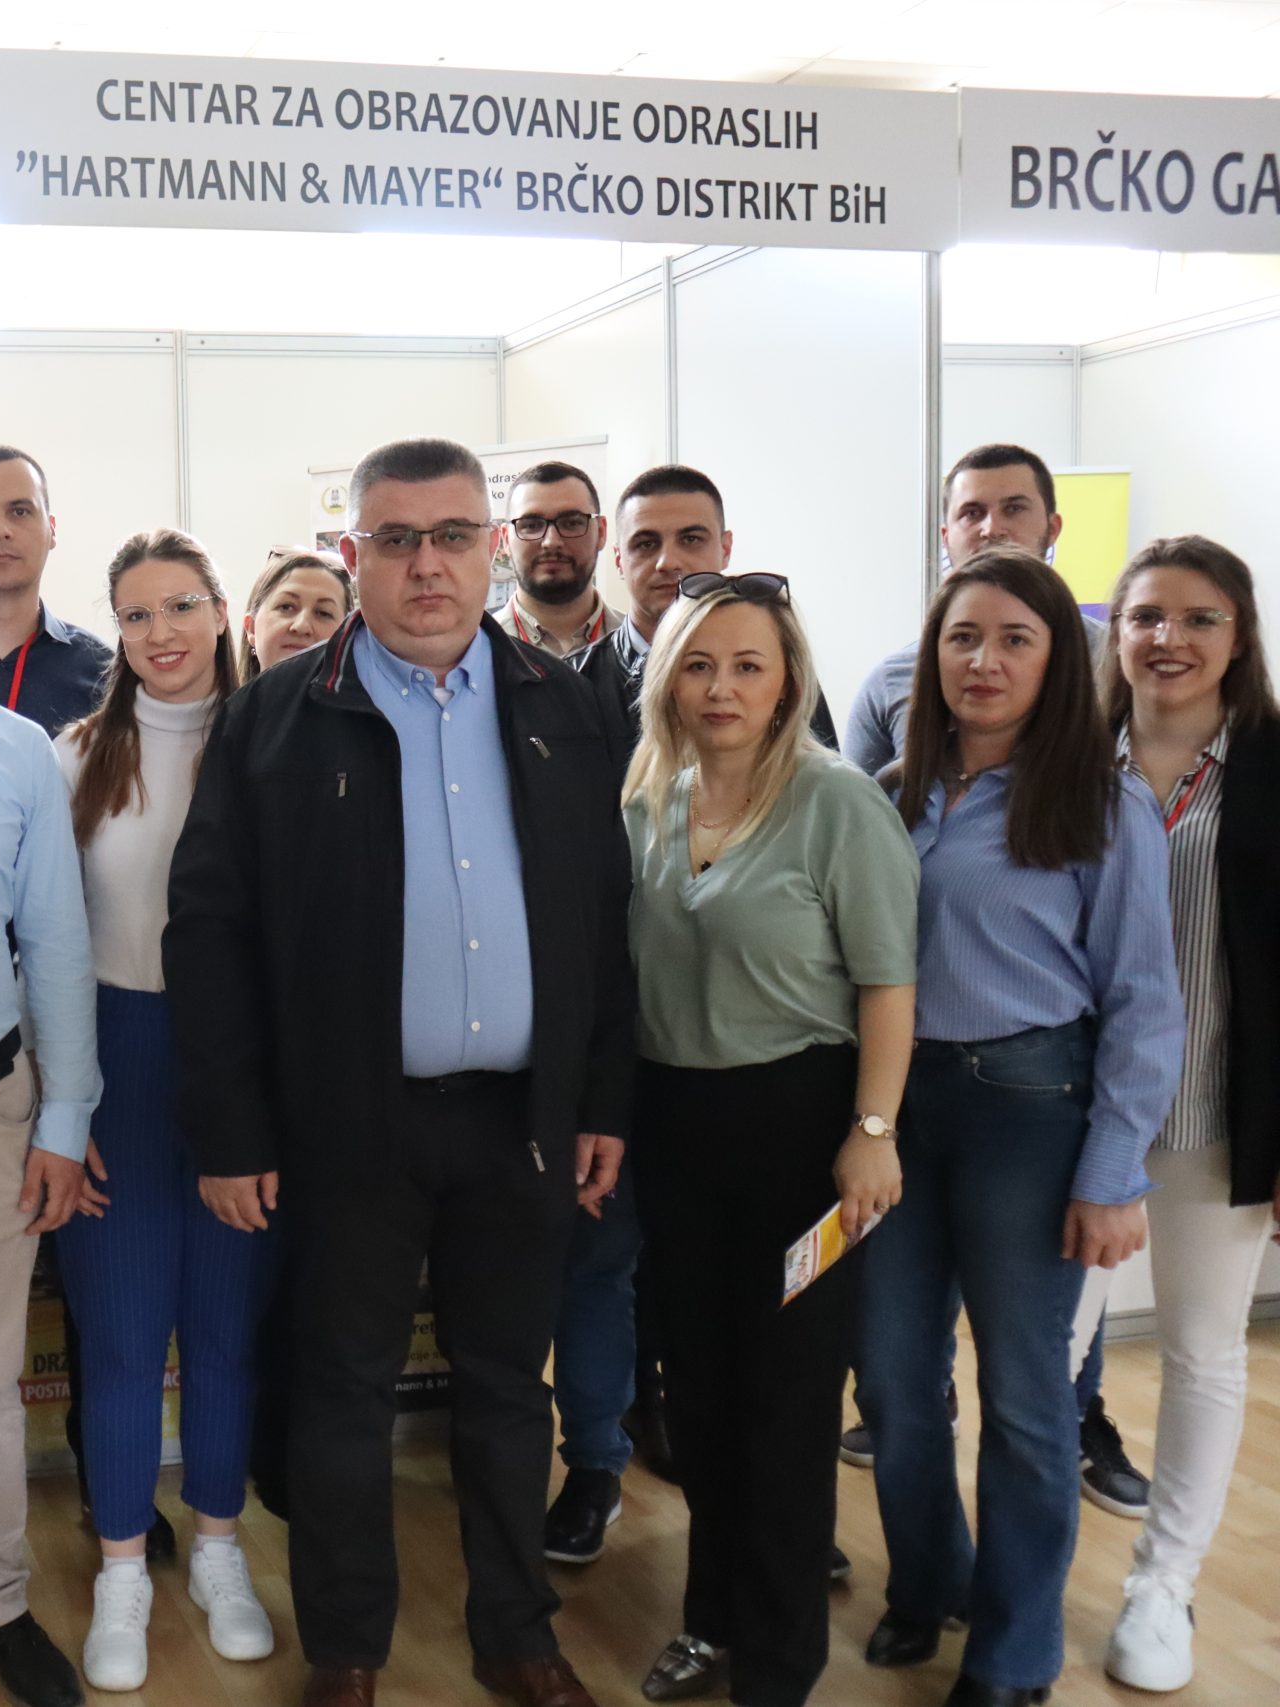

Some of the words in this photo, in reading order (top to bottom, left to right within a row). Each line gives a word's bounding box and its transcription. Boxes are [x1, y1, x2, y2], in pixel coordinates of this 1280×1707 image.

[96, 79, 261, 126] CENTAR
[272, 85, 324, 128] ZA
[335, 88, 622, 141] OBRAZOVANJE
[633, 102, 818, 150] ODRASLIH
[300, 162, 330, 204] &
[516, 162, 644, 216] BRČKO
[656, 177, 819, 222] DISTRIKT
[830, 182, 886, 225] BiH
[1011, 129, 1195, 214] BRČKO
[1212, 151, 1280, 215] GA
